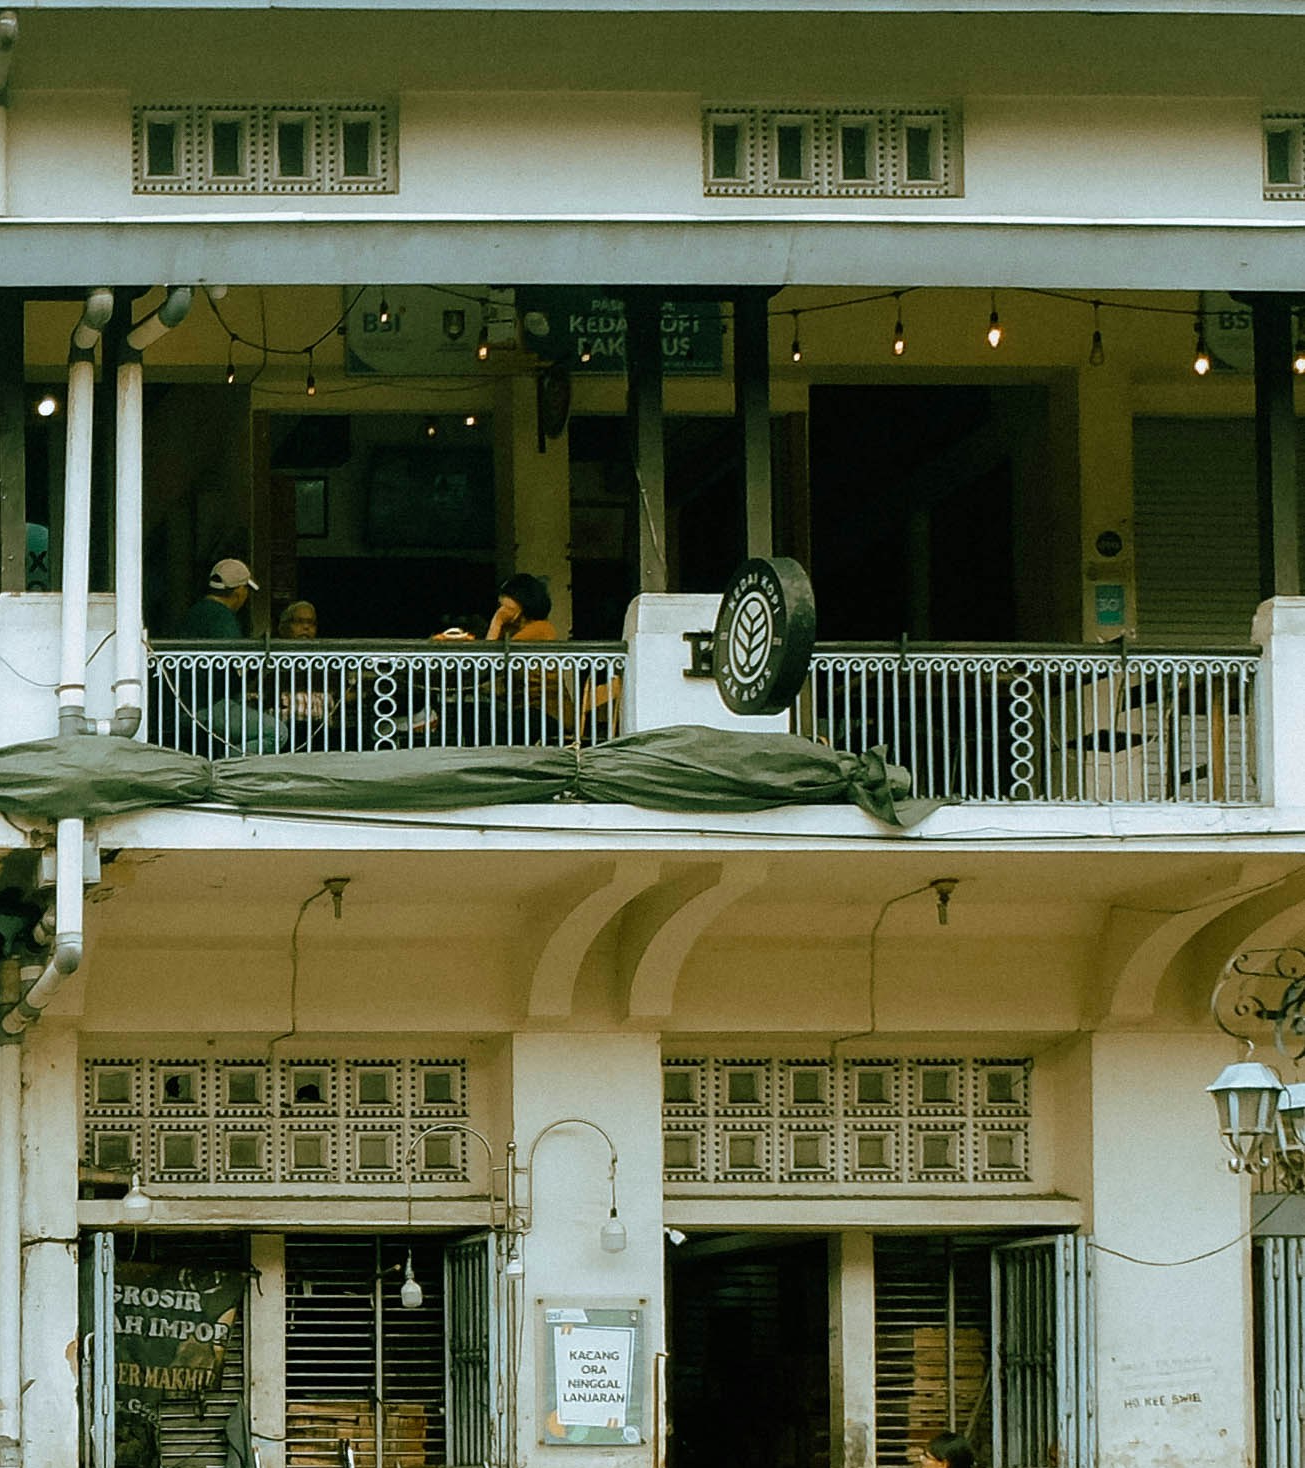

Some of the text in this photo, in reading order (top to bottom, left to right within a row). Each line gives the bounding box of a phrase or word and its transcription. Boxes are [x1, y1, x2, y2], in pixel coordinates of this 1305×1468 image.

[569, 314, 628, 333] KEDA
[1219, 311, 1249, 330] BS
[761, 575, 781, 614] KOPI
[741, 667, 772, 701] AGUS
[569, 1350, 620, 1361] KACANG
[580, 1364, 608, 1375] ORA
[567, 1379, 621, 1389] NINGGAL
[563, 1392, 626, 1404] LANJARAN
